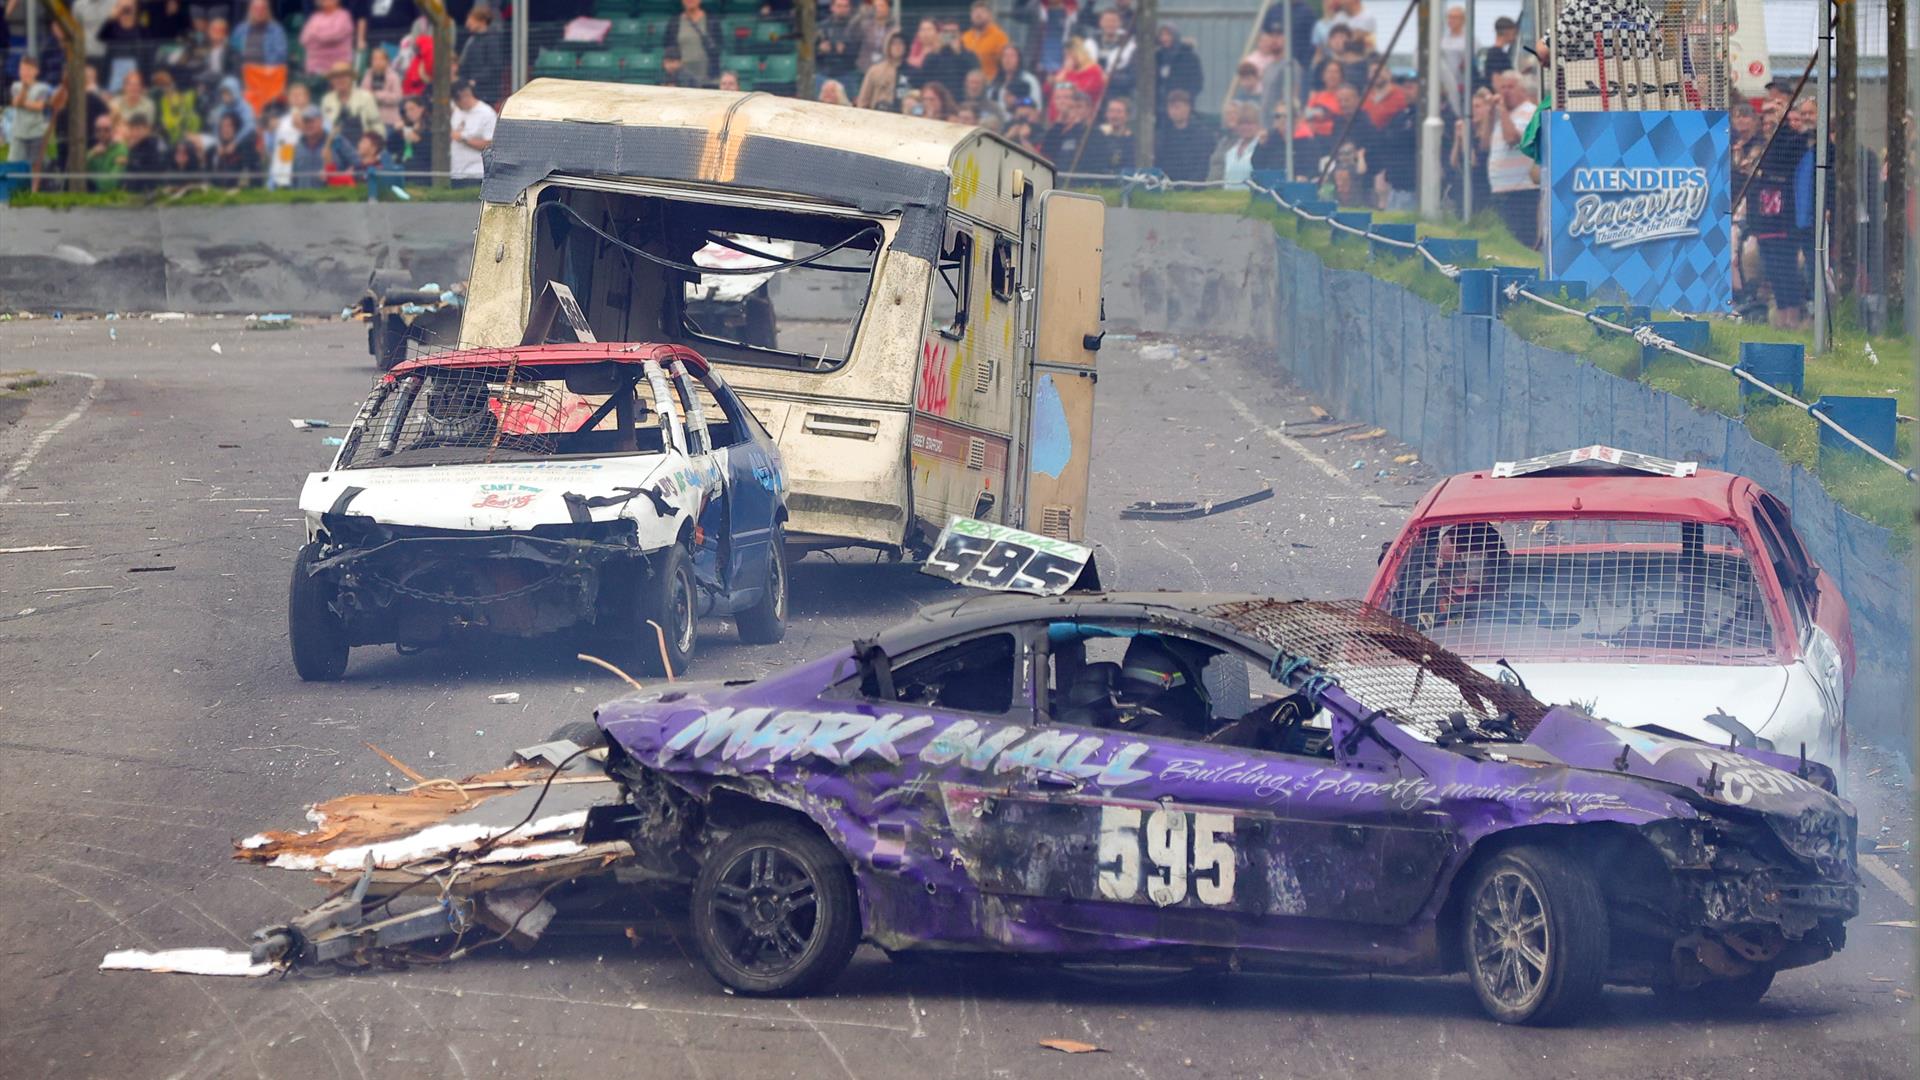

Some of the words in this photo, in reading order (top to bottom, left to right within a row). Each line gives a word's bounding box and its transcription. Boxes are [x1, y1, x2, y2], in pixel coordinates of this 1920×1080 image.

[1574, 168, 1705, 190] MENDIPS
[1570, 182, 1707, 236] Raceway
[1600, 227, 1633, 241] Thunder
[1634, 224, 1644, 234] in
[1646, 221, 1661, 232] the
[924, 532, 1084, 593] 595
[660, 706, 935, 768] MARK
[918, 718, 1152, 786] WALL
[1159, 759, 1292, 800] Building
[1307, 772, 1441, 811] property
[1099, 805, 1236, 907] 595
